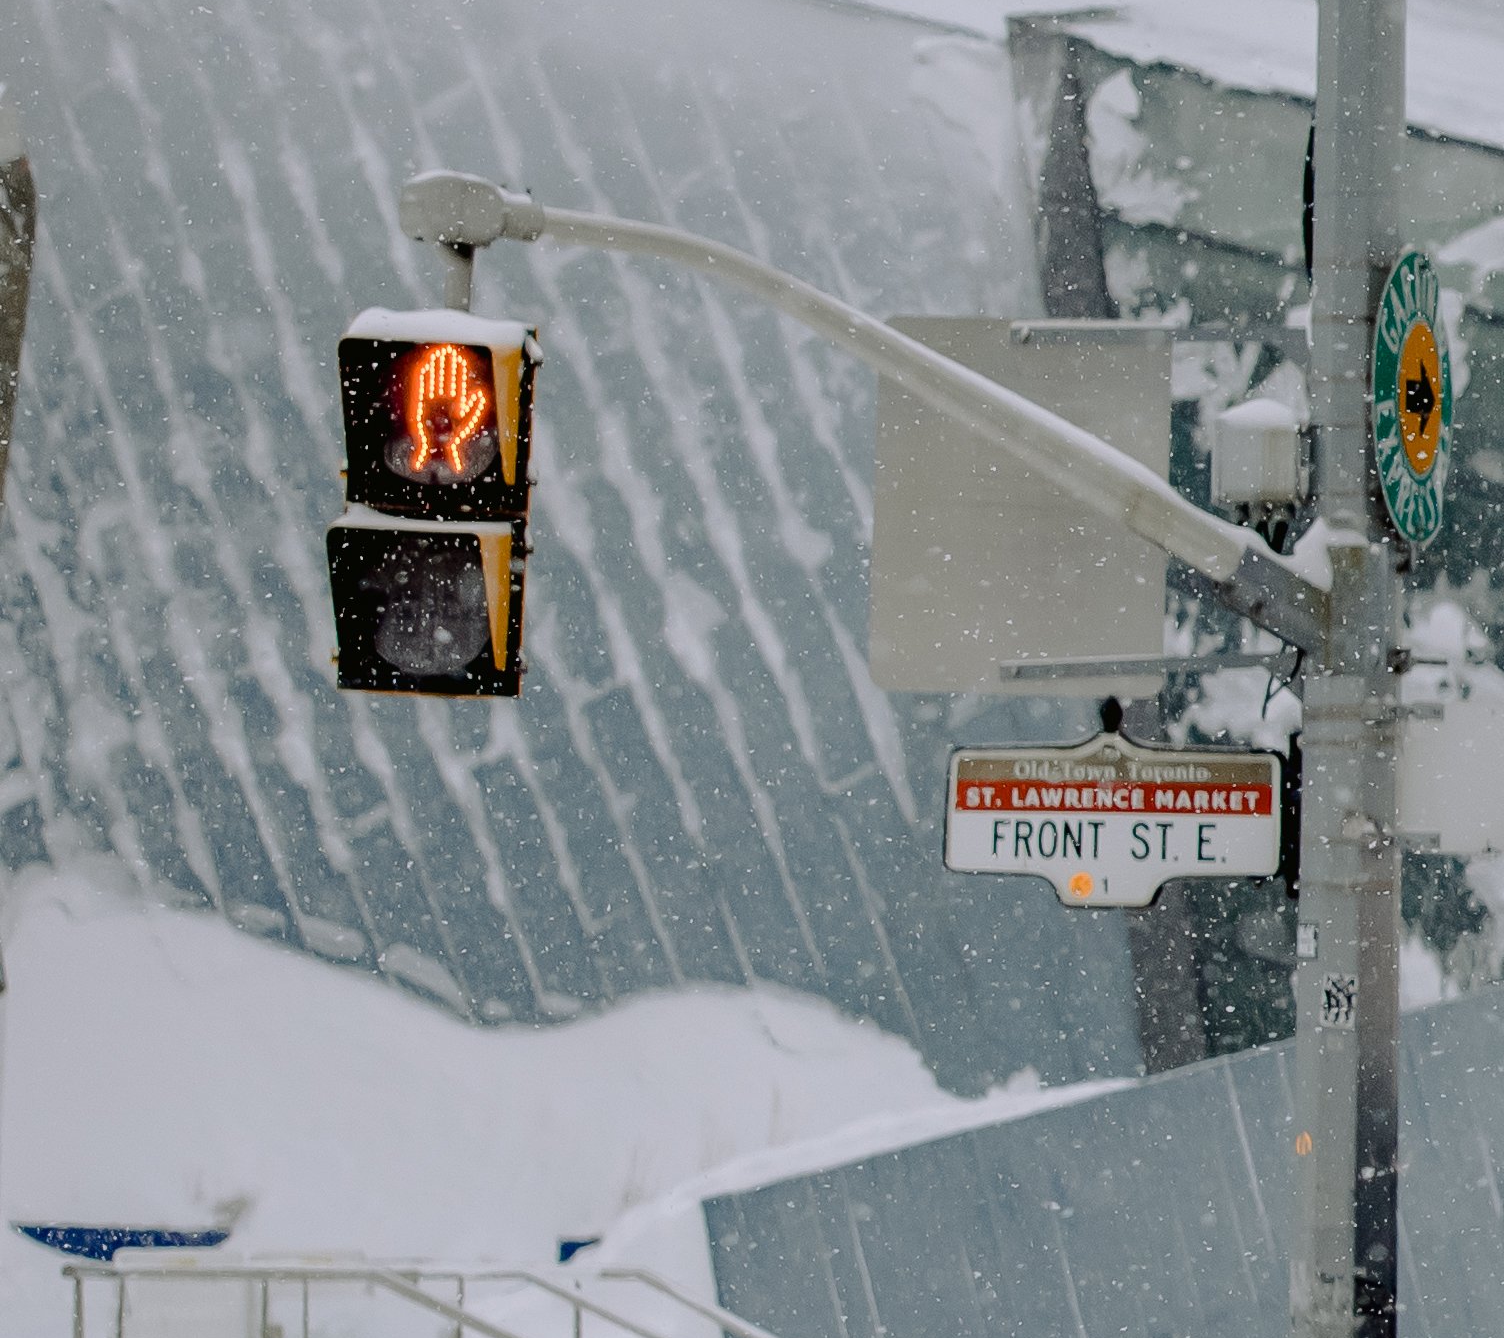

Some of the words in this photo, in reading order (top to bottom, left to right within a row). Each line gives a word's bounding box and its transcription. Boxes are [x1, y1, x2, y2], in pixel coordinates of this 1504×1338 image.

[1013, 760, 1051, 780] Old
[1060, 761, 1117, 782] Town
[1126, 762, 1212, 783] Toronto
[965, 786, 1002, 808] ST.
[1011, 786, 1146, 810] LAWRENCE
[1153, 788, 1261, 812] MARKET
[991, 819, 1105, 859] FRONT
[1131, 821, 1179, 862] ST.
[1196, 824, 1227, 863] E.
